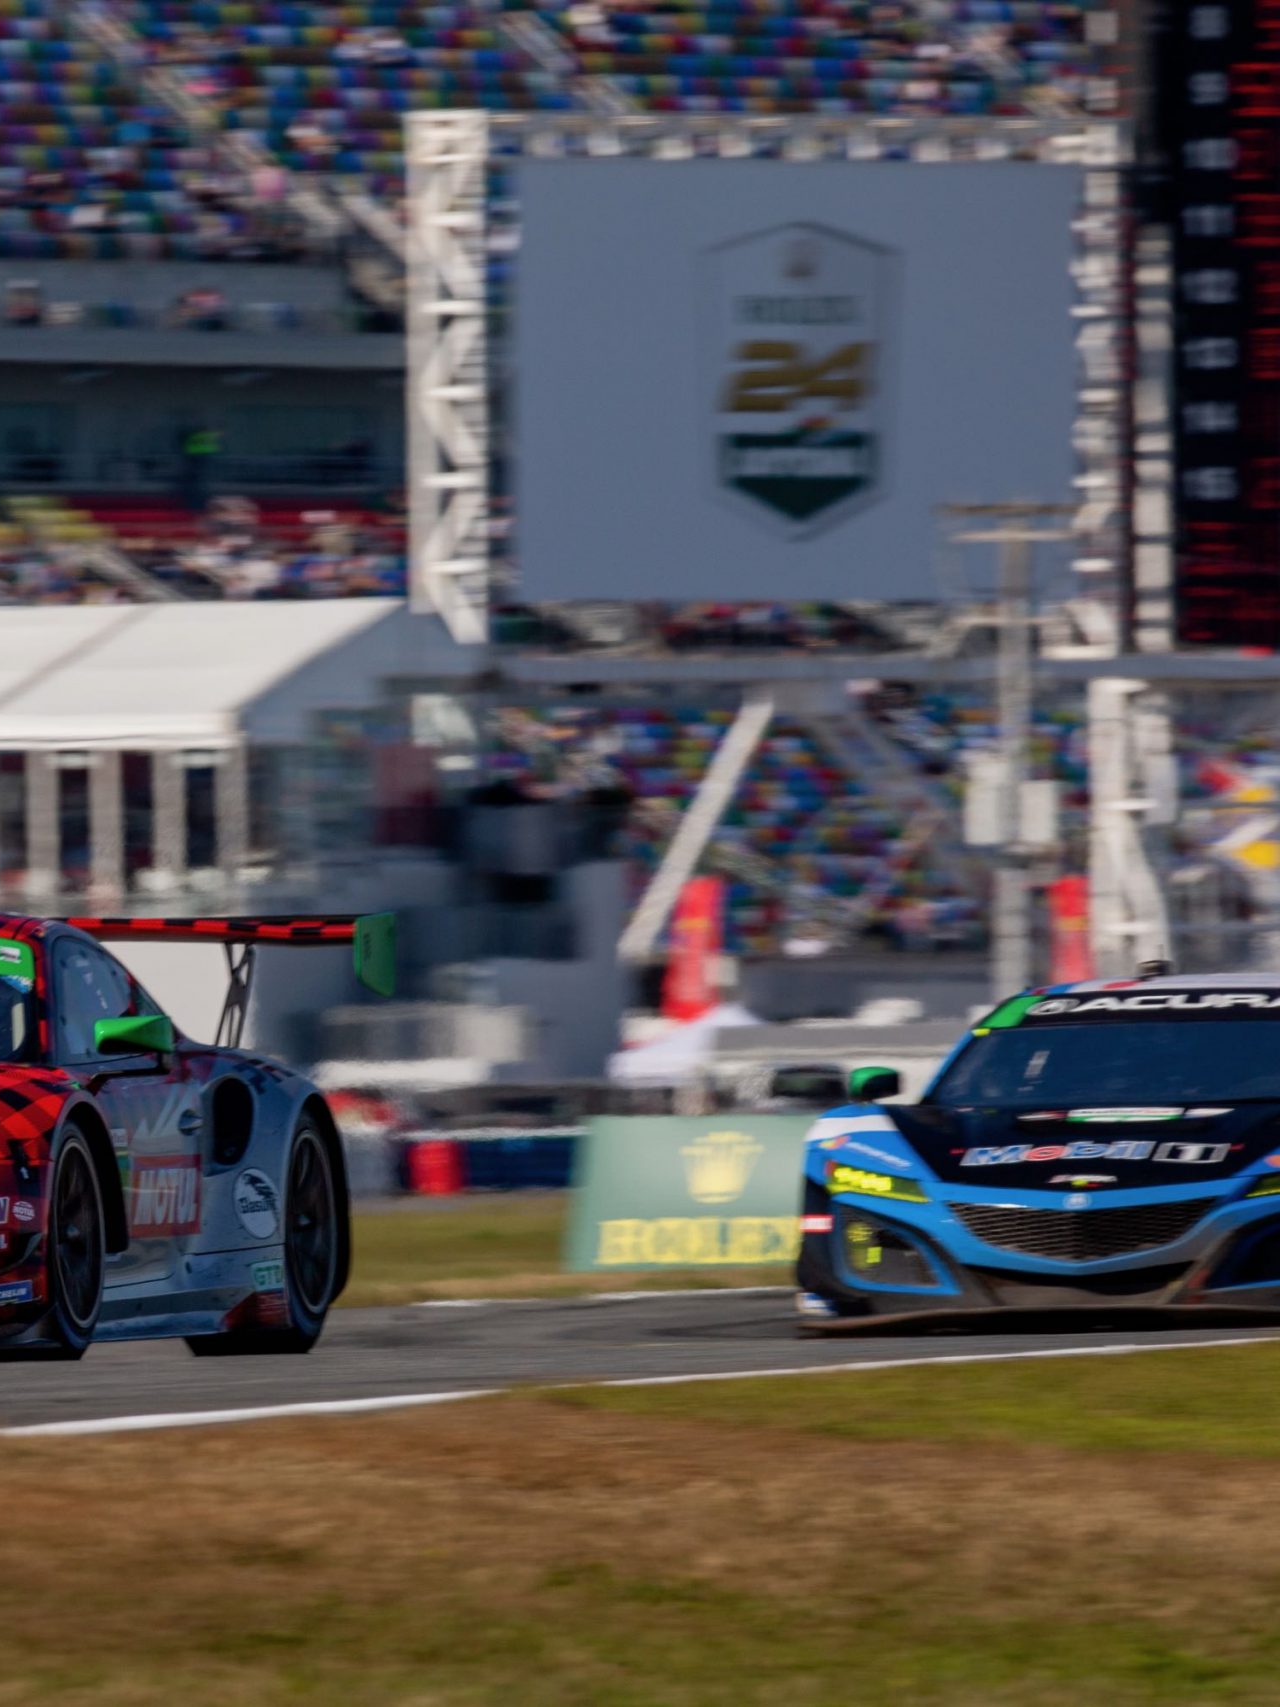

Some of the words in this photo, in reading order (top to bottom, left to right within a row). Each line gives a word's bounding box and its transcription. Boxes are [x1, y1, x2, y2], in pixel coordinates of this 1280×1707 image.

[726, 340, 874, 413] 24
[1070, 993, 1280, 1012] ACUR
[960, 1140, 1157, 1166] Mobil
[132, 1168, 197, 1226] MOTUL
